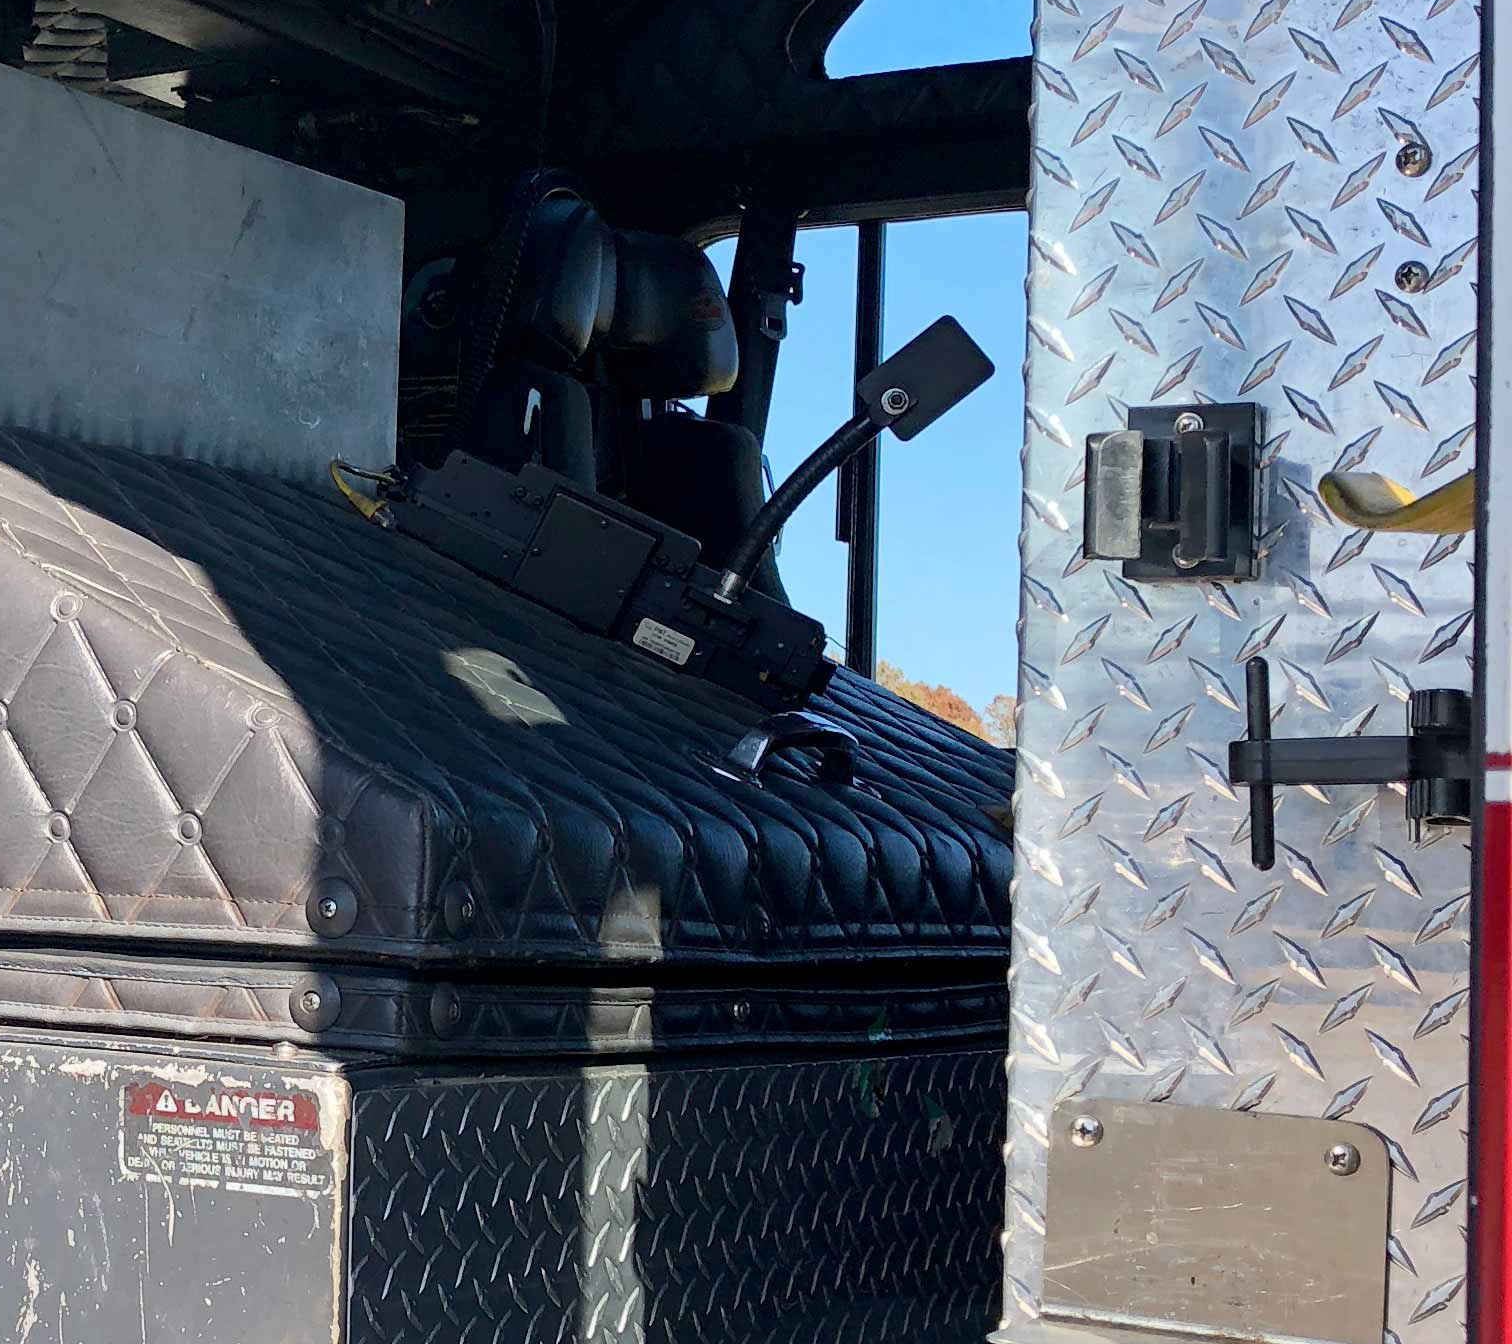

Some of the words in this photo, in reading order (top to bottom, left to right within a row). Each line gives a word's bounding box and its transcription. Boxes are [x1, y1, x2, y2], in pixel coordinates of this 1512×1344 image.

[152, 1123, 210, 1138] PERSONNEL
[212, 1127, 241, 1140] MUST
[243, 1131, 257, 1142] BE
[138, 1133, 157, 1145] AND
[216, 1140, 244, 1153] MUST
[247, 1142, 261, 1155] BE
[264, 1145, 316, 1160] FASTENED
[148, 1146, 173, 1158] WHI
[179, 1149, 219, 1163] VEHICLE
[222, 1153, 231, 1164] IS
[248, 1156, 288, 1170] MOTION
[291, 1160, 307, 1172] OR
[161, 1159, 175, 1170] OR
[225, 1166, 259, 1180] INJURY
[263, 1170, 283, 1182] MAY
[287, 1172, 325, 1185] RESULT
